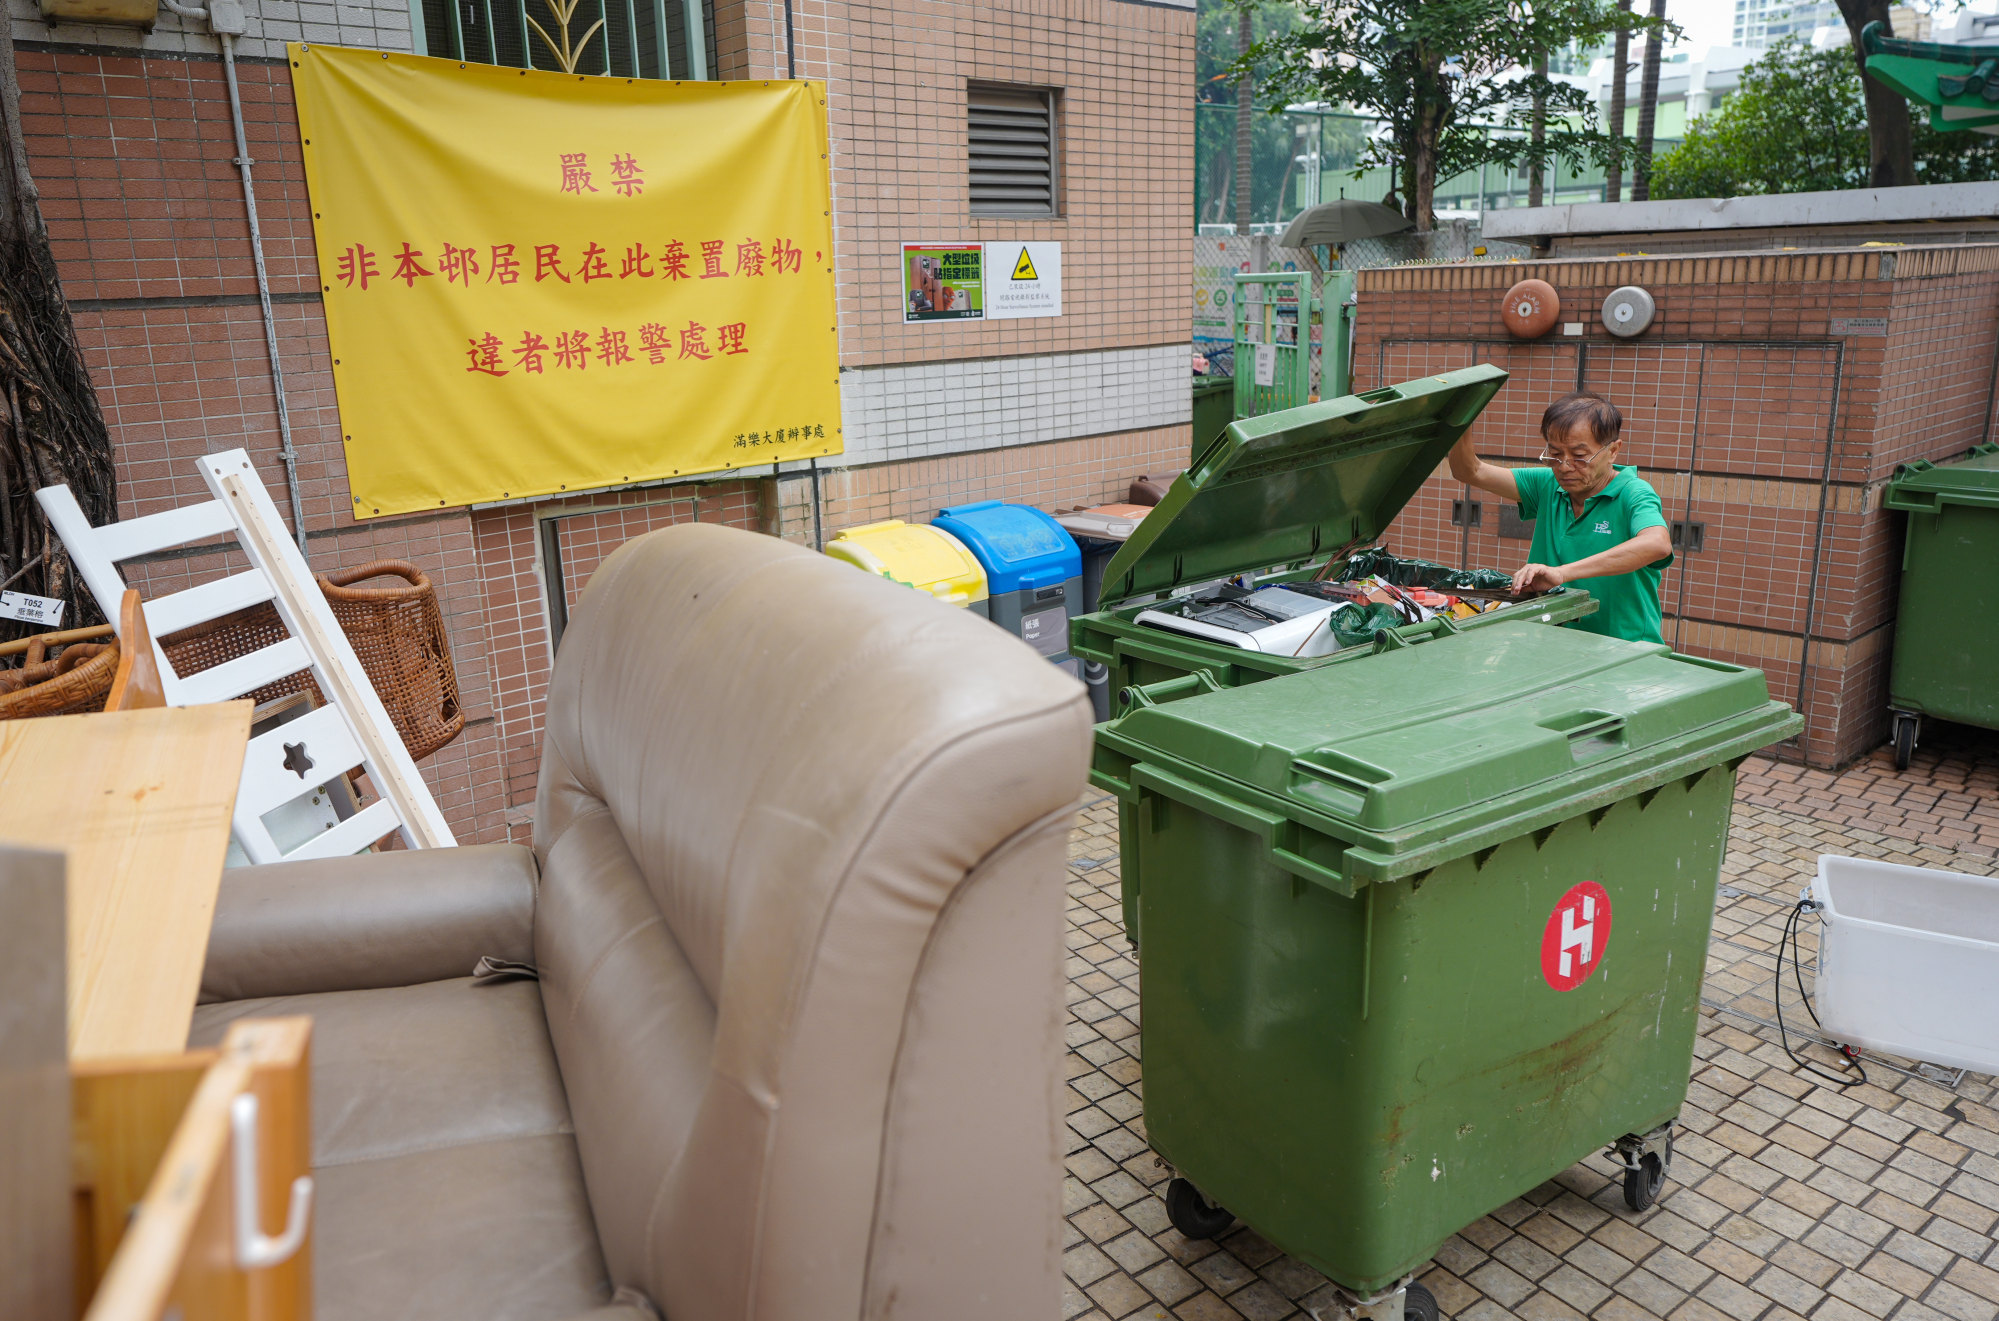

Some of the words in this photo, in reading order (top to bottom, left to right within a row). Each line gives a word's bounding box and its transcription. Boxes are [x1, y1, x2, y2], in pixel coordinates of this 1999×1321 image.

[560, 152, 645, 197] 嚴禁
[466, 320, 749, 377] 違者將報警處理
[24, 598, 43, 608] T052
[1025, 632, 1040, 640] Paper
